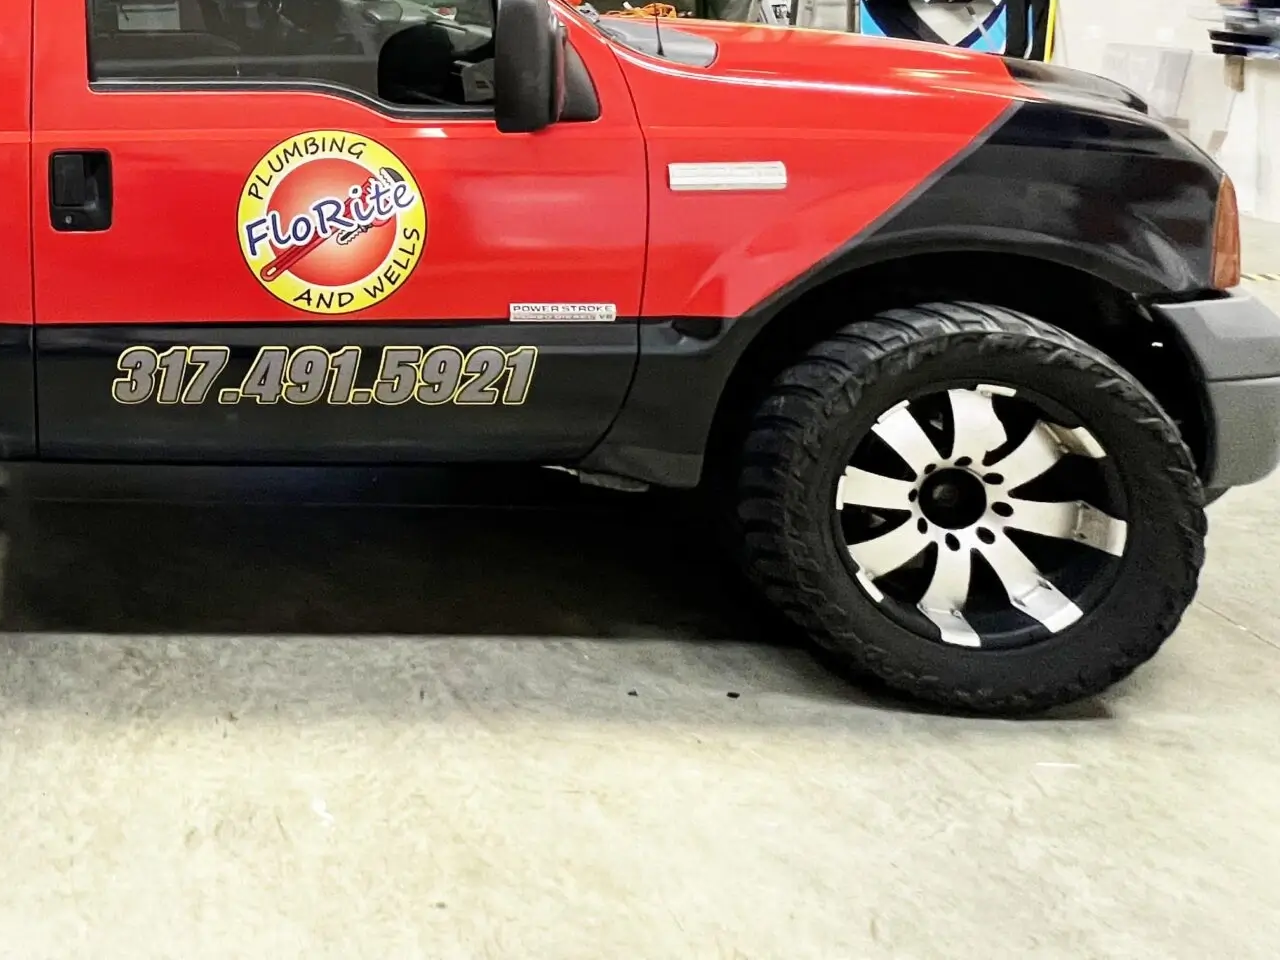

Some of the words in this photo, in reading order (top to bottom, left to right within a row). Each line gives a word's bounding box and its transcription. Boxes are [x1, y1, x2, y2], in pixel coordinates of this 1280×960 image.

[247, 136, 367, 200] PLUMBING
[245, 182, 415, 256] FloRite
[293, 288, 355, 309] AND
[363, 227, 420, 299] WELLS
[513, 305, 559, 313] POWER
[113, 345, 538, 406] 317.491.5921
